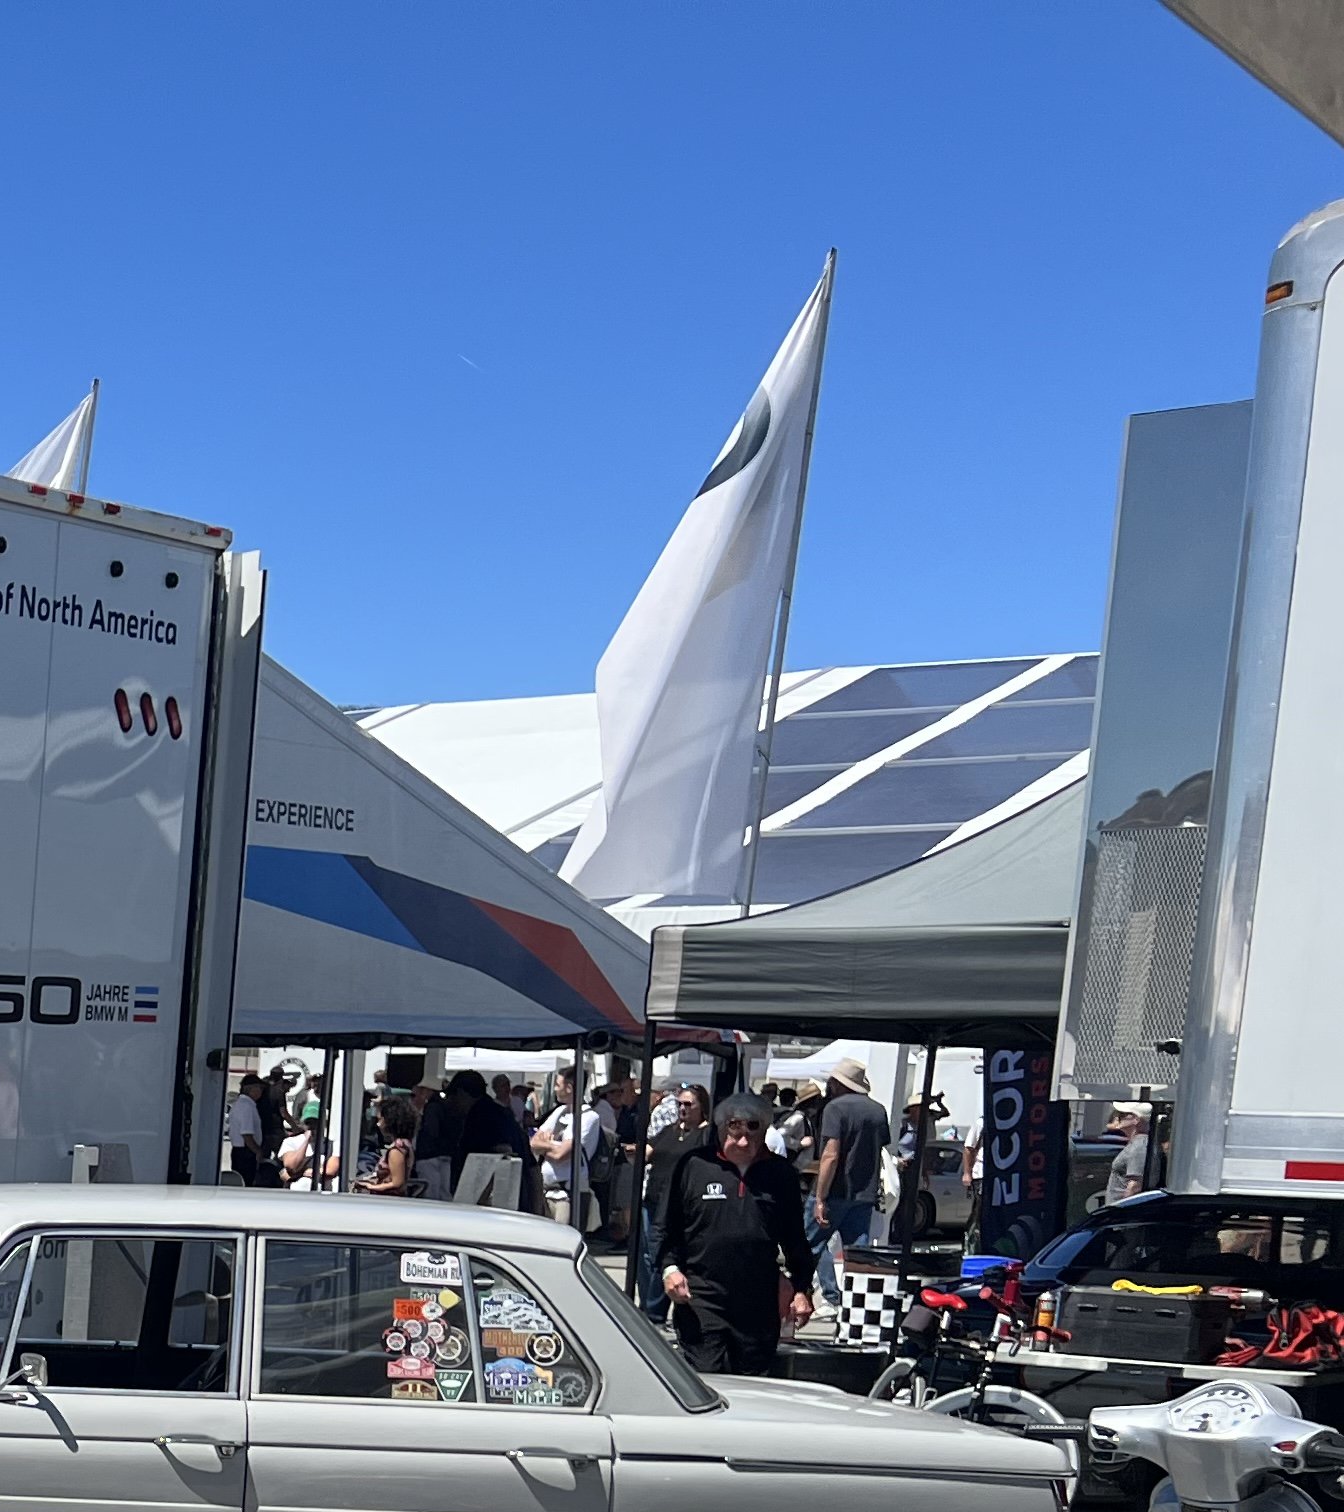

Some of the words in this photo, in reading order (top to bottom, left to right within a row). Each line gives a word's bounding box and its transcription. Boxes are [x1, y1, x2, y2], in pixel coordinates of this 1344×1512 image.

[19, 584, 83, 628] North
[88, 600, 178, 645] America
[255, 799, 355, 831] EXPERIENCE
[86, 984, 129, 1003] JAHRE
[85, 1004, 113, 1022] BMW
[117, 1006, 128, 1022] M
[990, 1050, 1025, 1206] ECOR
[1027, 1056, 1050, 1199] MOTORS
[406, 1262, 448, 1280] BOHEMIAN
